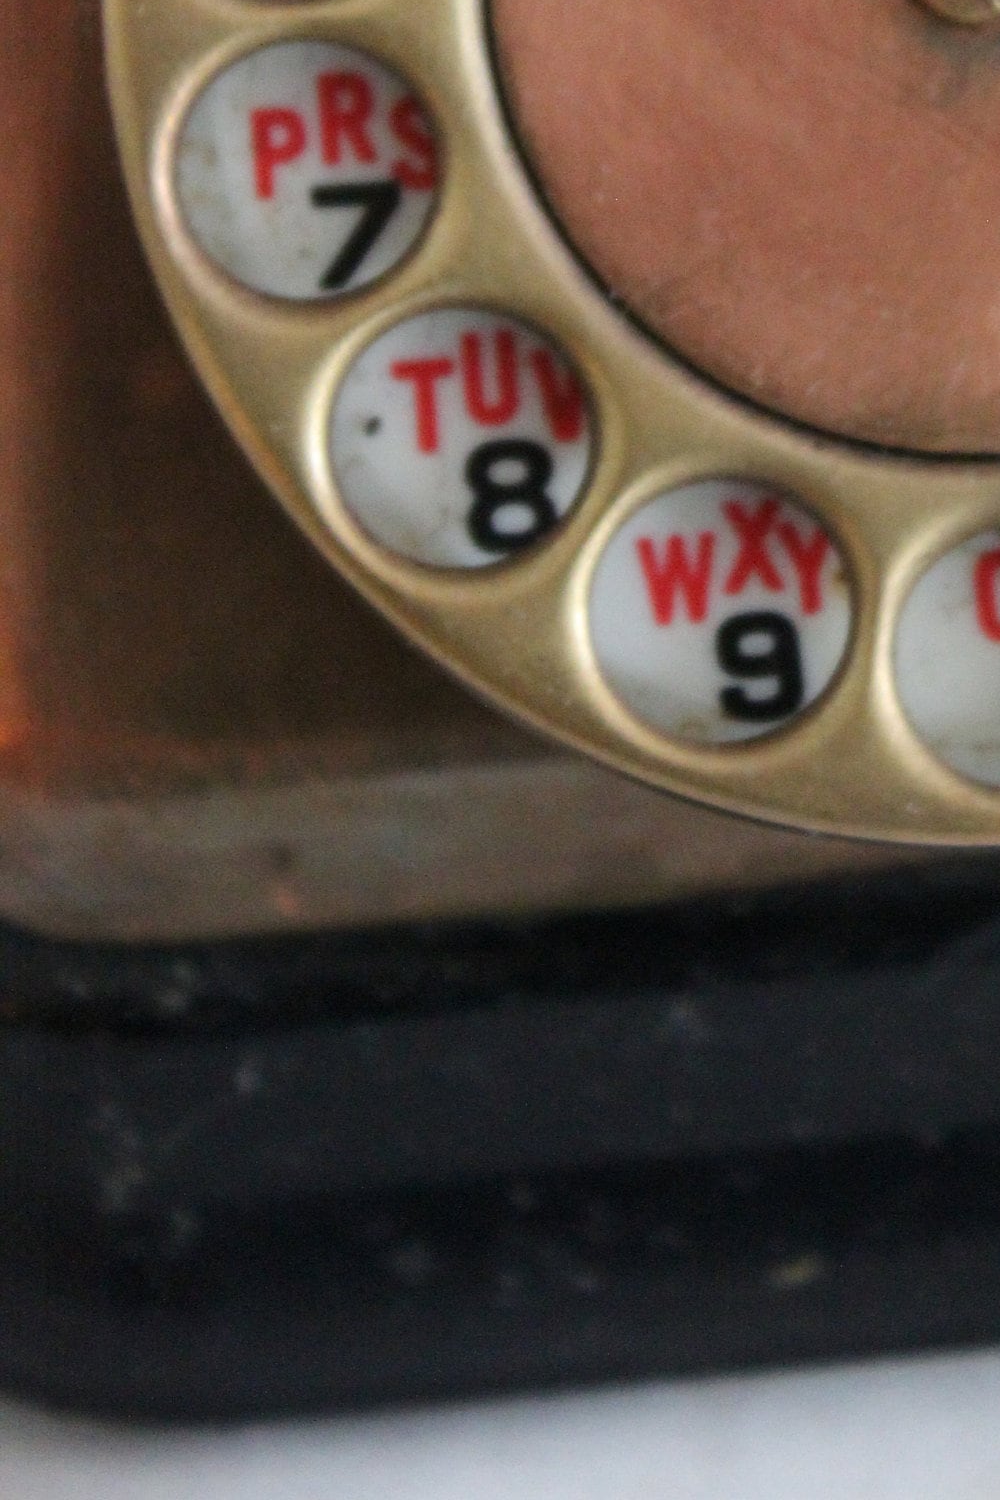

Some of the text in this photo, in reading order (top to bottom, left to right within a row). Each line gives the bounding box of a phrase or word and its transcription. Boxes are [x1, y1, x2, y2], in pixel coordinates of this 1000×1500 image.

[247, 68, 438, 201] PRS
[309, 176, 403, 292] 7
[464, 438, 562, 555] 8
[635, 500, 834, 627] WXY
[713, 610, 805, 723] 9
